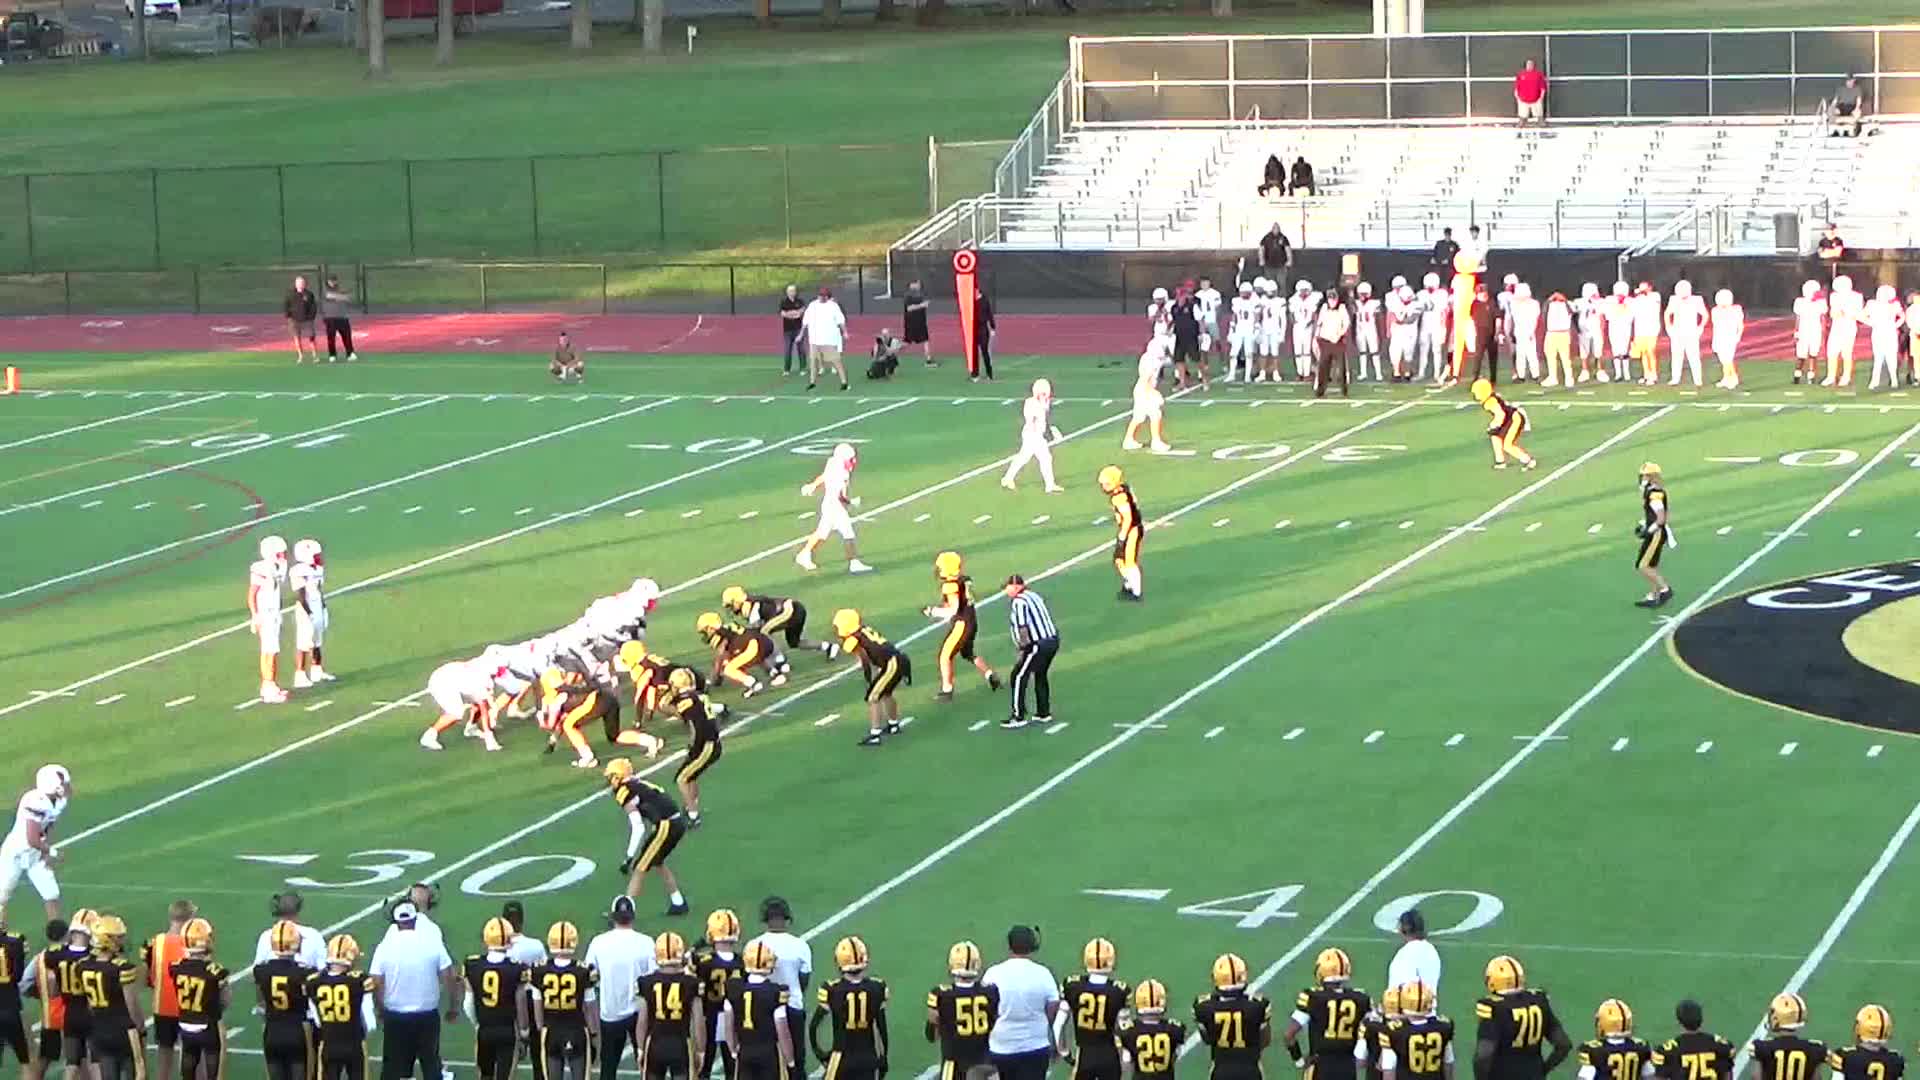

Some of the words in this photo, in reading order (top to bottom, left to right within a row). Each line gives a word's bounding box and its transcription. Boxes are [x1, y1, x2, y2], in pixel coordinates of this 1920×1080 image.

[1746, 560, 1920, 609] CE
[81, 970, 109, 1008] 51
[175, 974, 206, 1013] 27
[269, 975, 289, 1011] 5
[317, 983, 351, 1023] 28
[482, 969, 500, 1008] 9
[542, 972, 578, 1011] 22
[652, 982, 684, 1021] 14
[742, 991, 755, 1030] 1
[845, 991, 869, 1030] 11
[955, 995, 989, 1037] 56
[1076, 991, 1108, 1031] 21
[1213, 1011, 1247, 1049] 71
[1324, 999, 1358, 1041] 12
[1511, 1004, 1543, 1049] 70
[1135, 1032, 1172, 1073] 29
[1408, 1031, 1443, 1074] 62
[1607, 1051, 1640, 1080] 30
[1681, 1051, 1718, 1080] 75
[1773, 1049, 1807, 1080] 10
